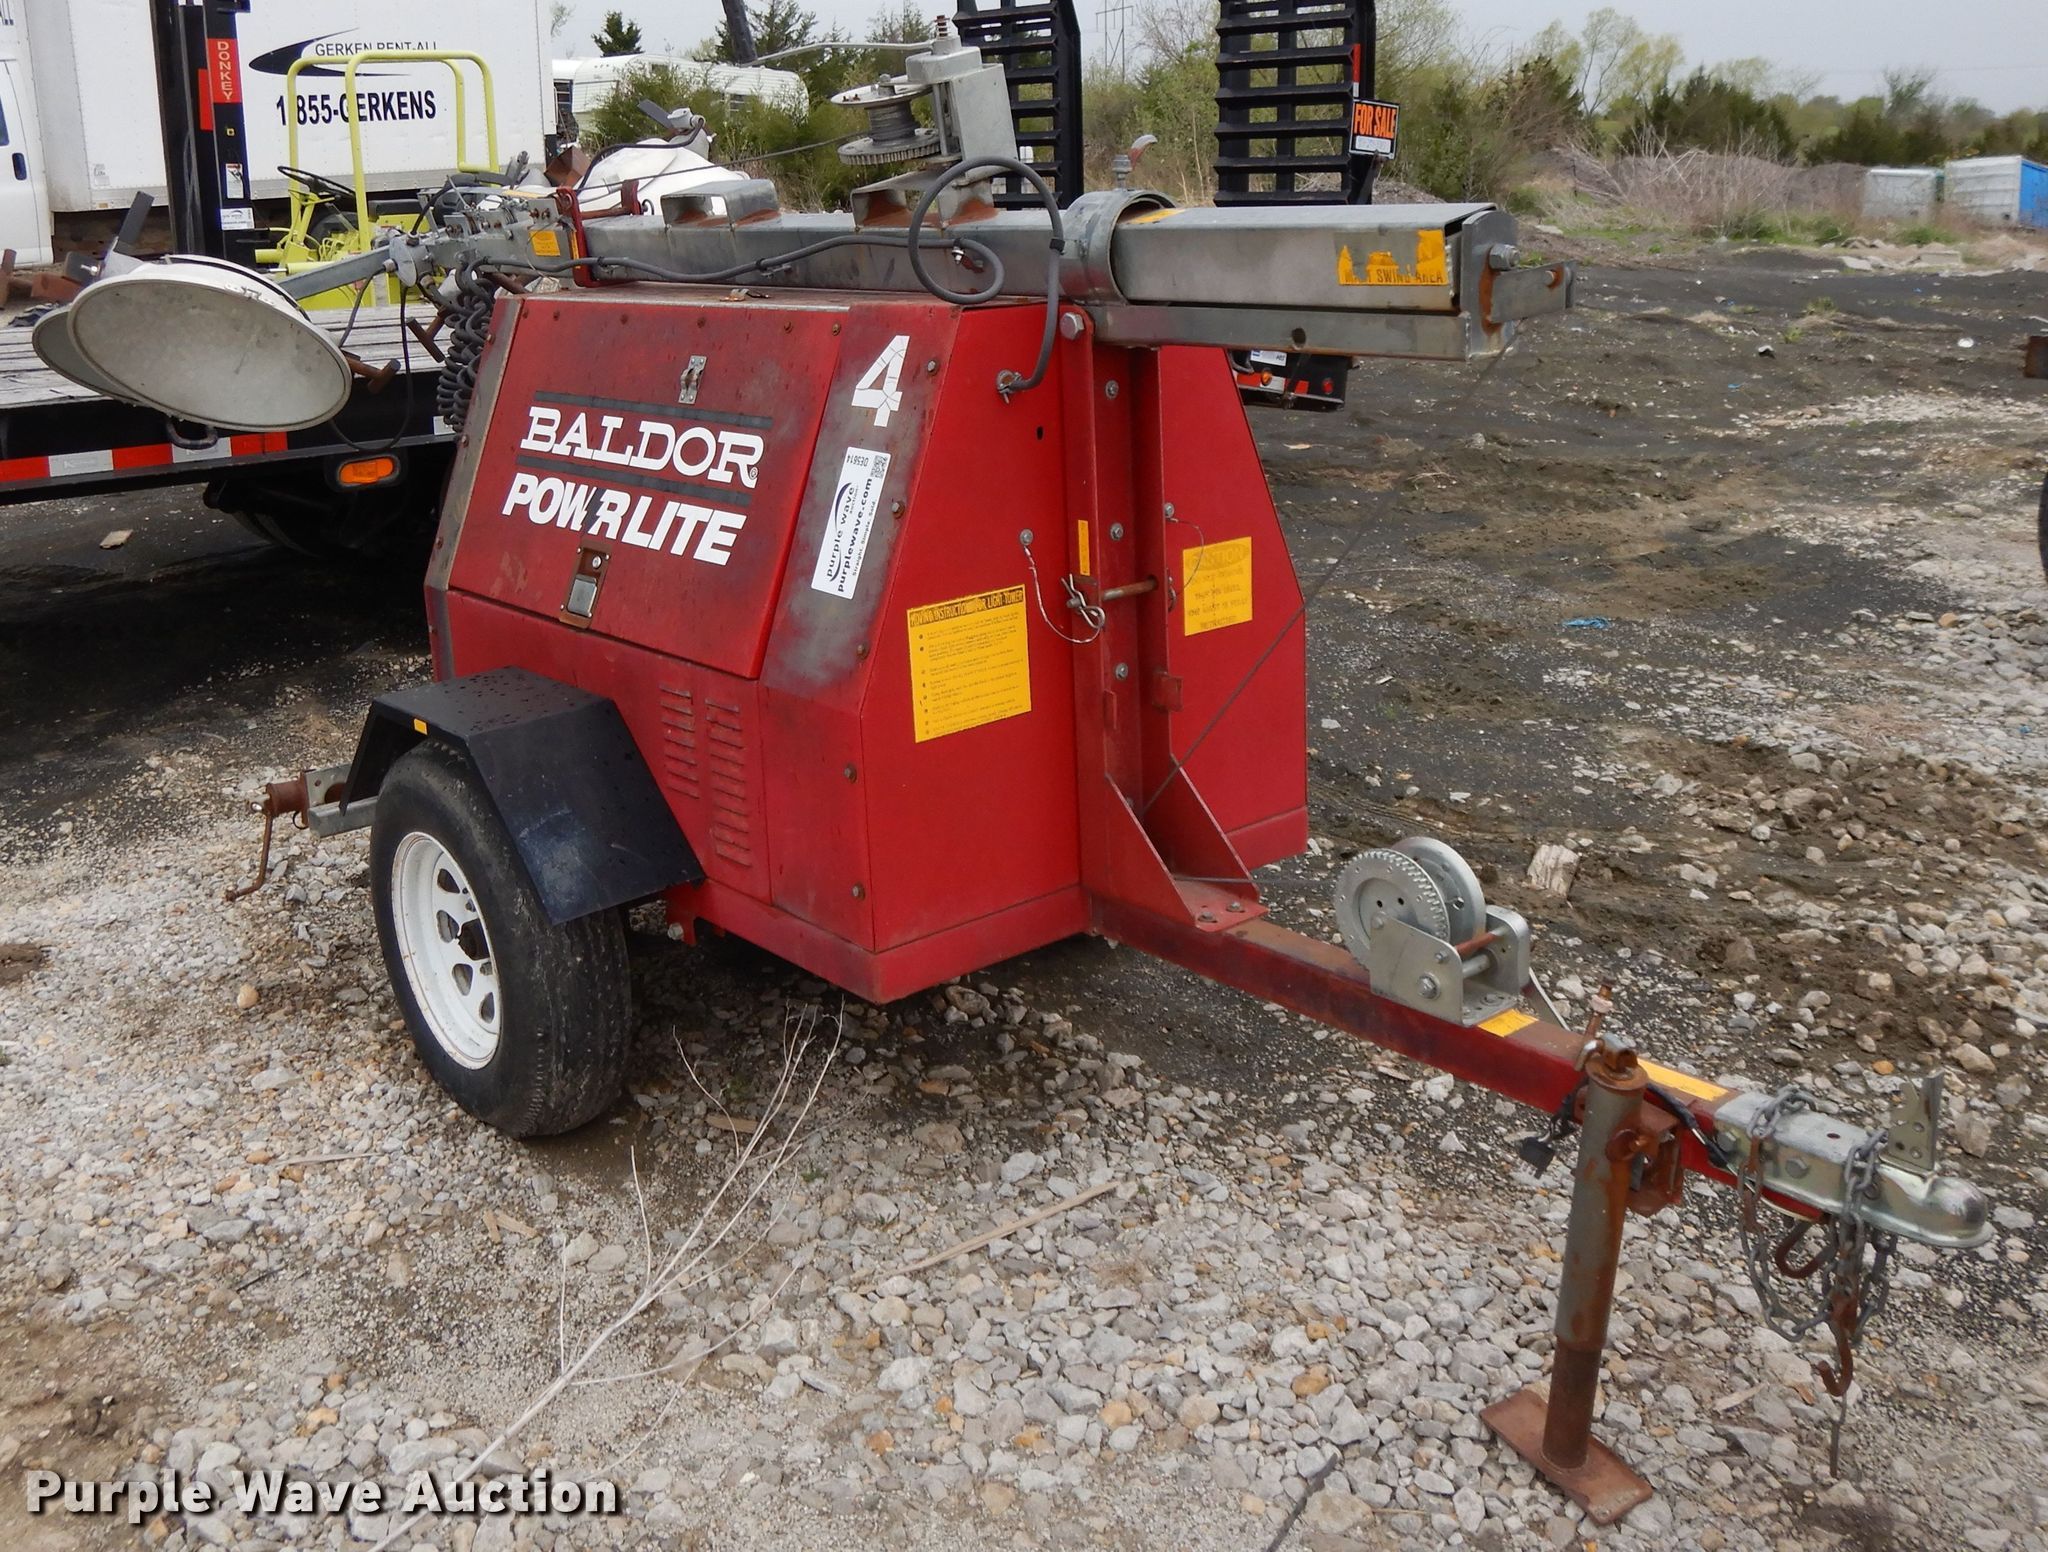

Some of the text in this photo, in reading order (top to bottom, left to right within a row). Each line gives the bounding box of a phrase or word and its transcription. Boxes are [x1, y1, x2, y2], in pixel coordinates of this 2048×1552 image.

[216, 40, 234, 100] DONKEY
[315, 42, 373, 57] GERKEN
[1354, 103, 1397, 139] FOR SALE
[851, 335, 910, 427] 4
[520, 406, 764, 489] BALDOR
[826, 487, 855, 577] purple wave
[838, 478, 873, 592] purplewave.com
